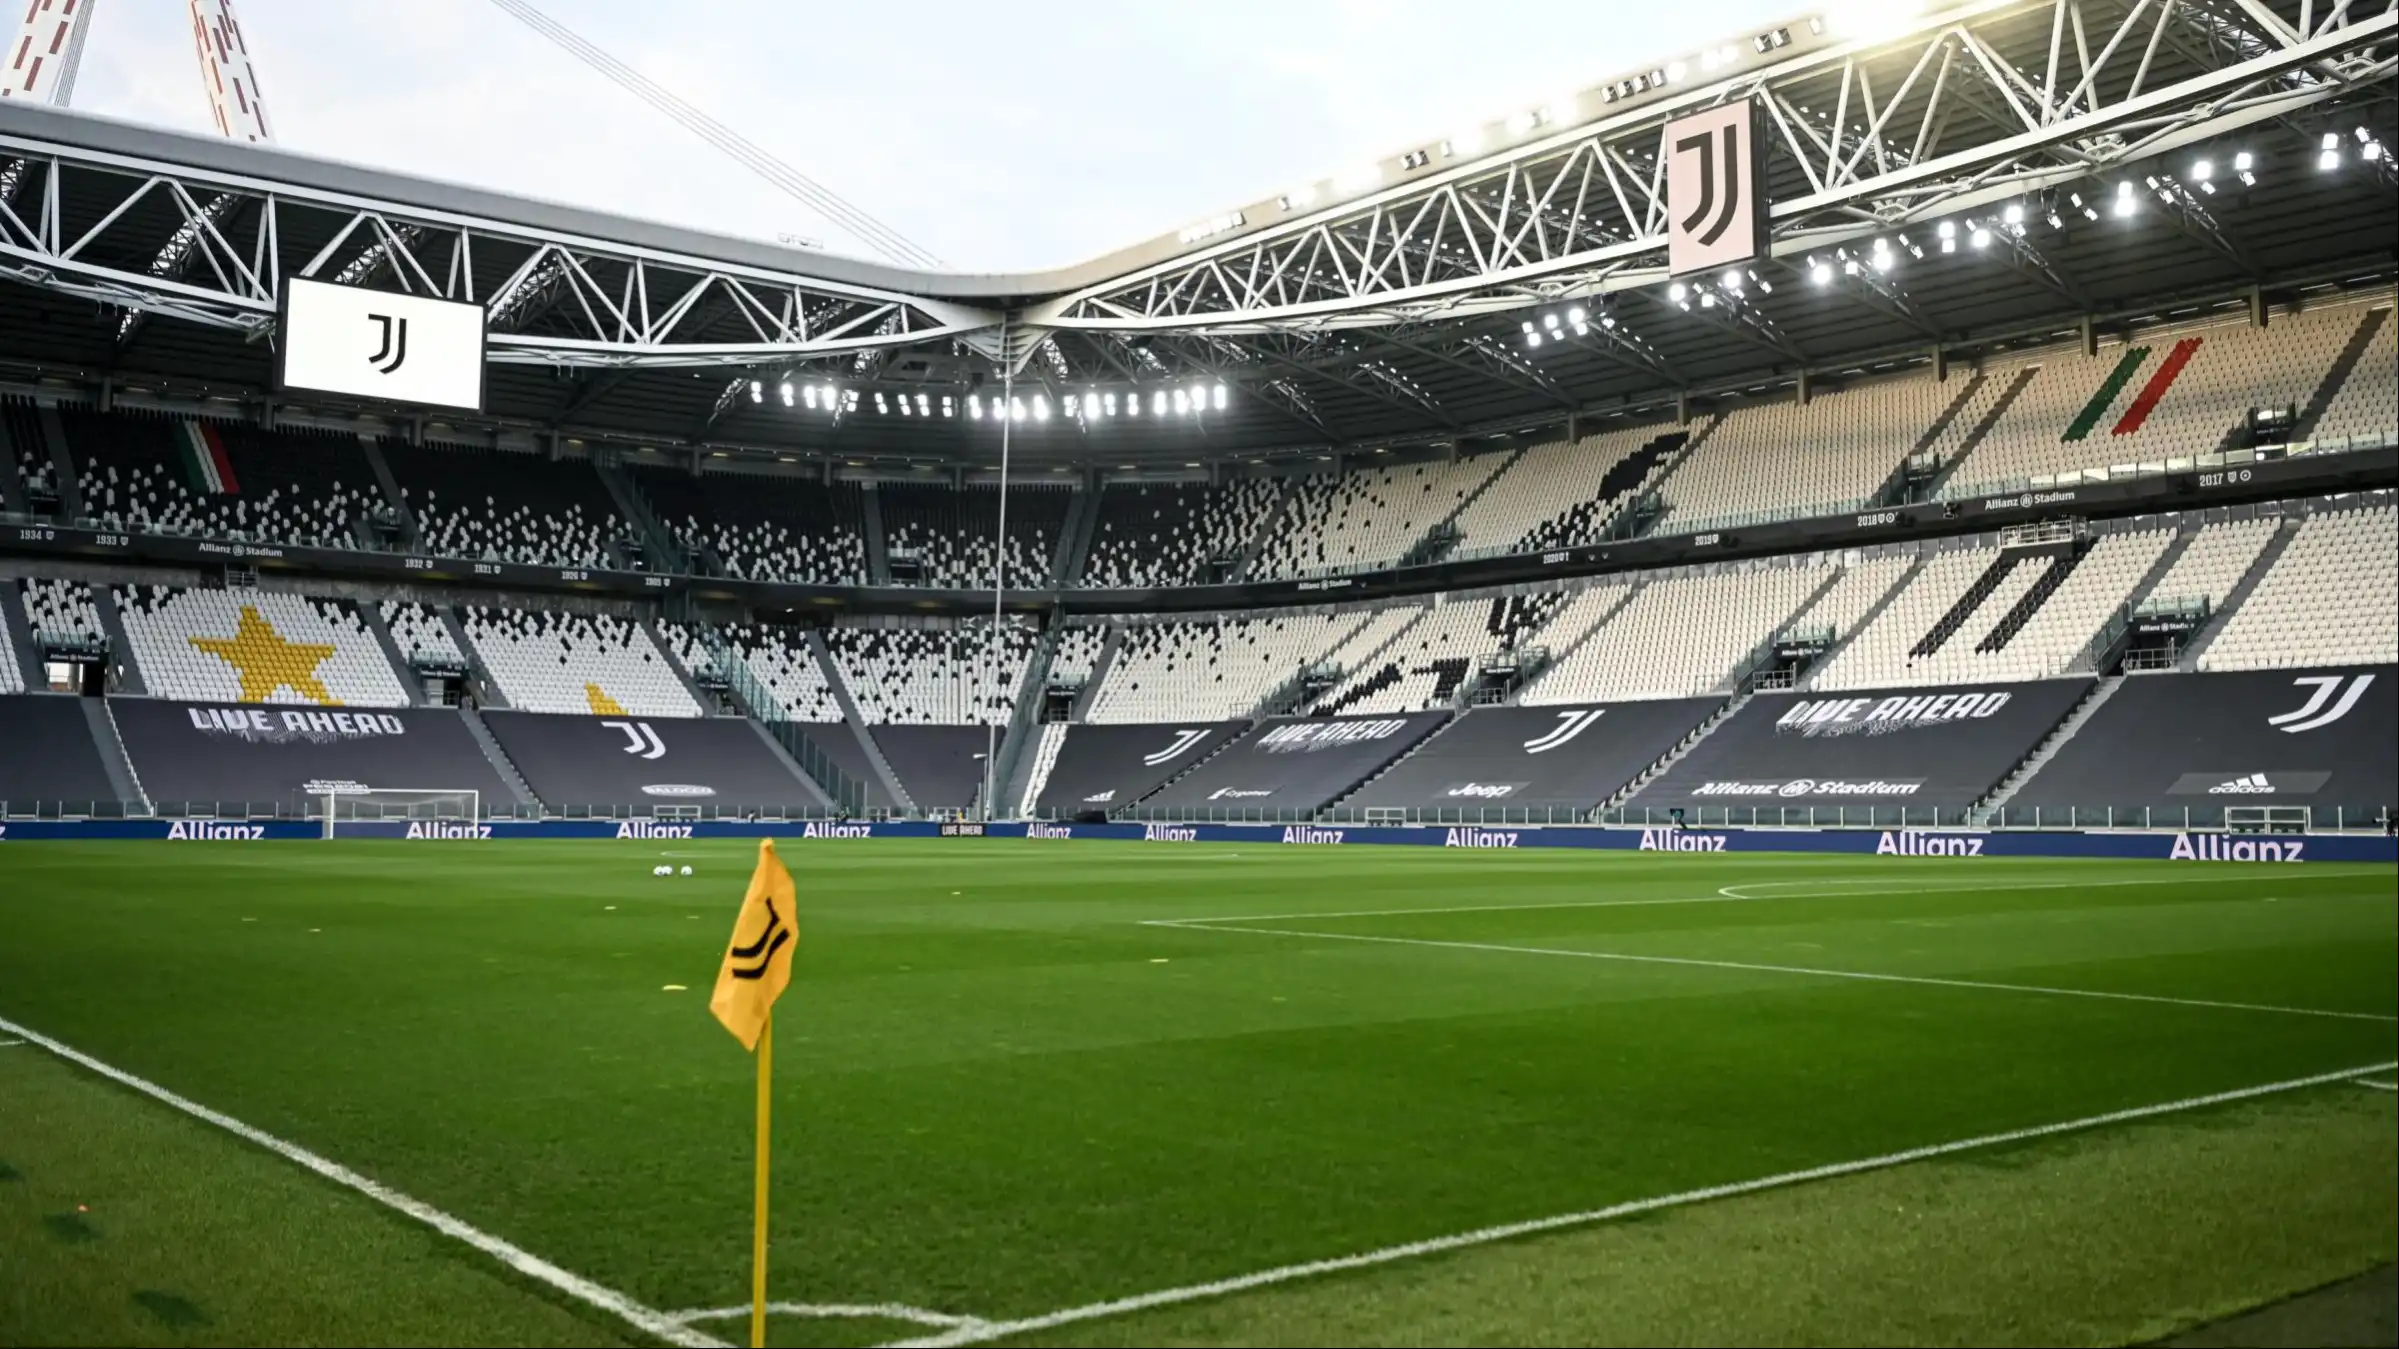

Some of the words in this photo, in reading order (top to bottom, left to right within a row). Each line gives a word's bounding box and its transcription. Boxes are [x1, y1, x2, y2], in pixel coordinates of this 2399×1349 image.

[2199, 472, 2224, 487] 2017
[1985, 499, 2019, 511] Allianz
[2034, 491, 2075, 504] Stadium
[1857, 514, 1877, 526] 2018
[20, 529, 42, 540] 1934
[96, 534, 117, 545] 1933
[199, 542, 231, 554] Allianz
[246, 546, 283, 557] Stadium
[1775, 699, 1872, 726] LIVE
[1864, 691, 2012, 722] AHEAD
[187, 707, 275, 732] LIVE
[280, 710, 406, 735] AHEAD
[1310, 718, 1408, 742] AHEAD
[1447, 782, 1513, 799] Jeep
[1692, 781, 1780, 796] Allianz
[1813, 780, 1922, 795] Stadium
[2208, 784, 2276, 794] adidas
[167, 821, 265, 840] Allianz
[406, 821, 491, 839] Allianz
[616, 821, 693, 839] Allianz
[803, 822, 871, 838] Allianz
[942, 824, 958, 836] LIVE
[960, 824, 983, 836] AHEAD
[1026, 823, 1072, 839] Allianz
[1144, 824, 1197, 841] Allianz
[1282, 826, 1344, 844] Allianz
[1445, 828, 1518, 848] Allianz
[1639, 829, 1727, 852] Allianz
[1876, 831, 1984, 857] Allianz
[2169, 832, 2304, 862] Allianz
